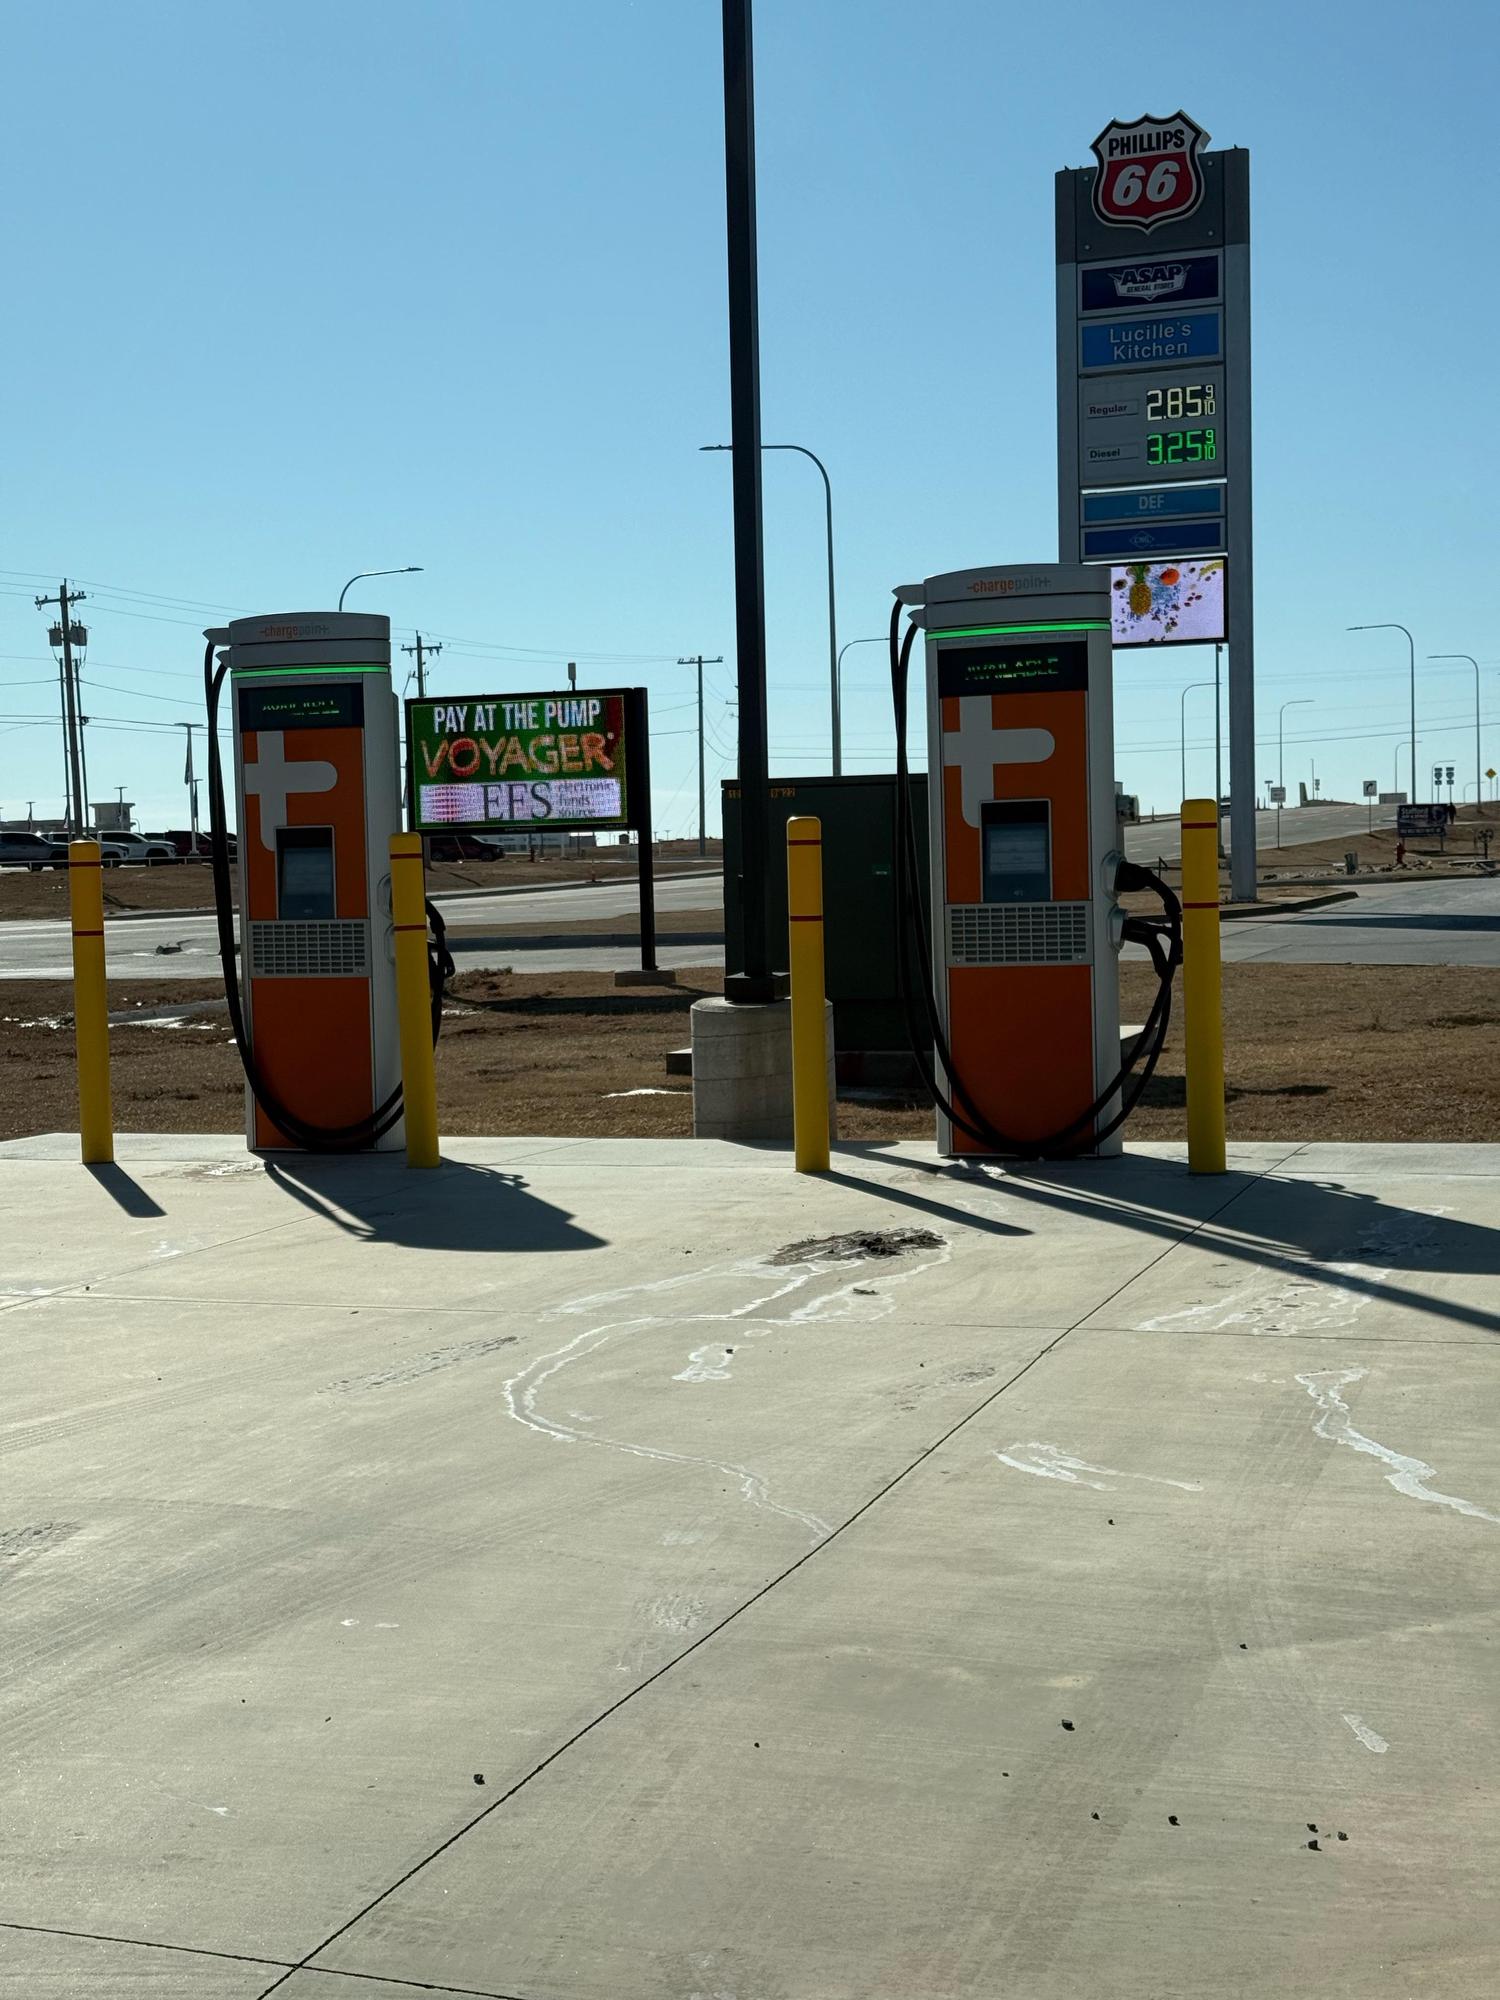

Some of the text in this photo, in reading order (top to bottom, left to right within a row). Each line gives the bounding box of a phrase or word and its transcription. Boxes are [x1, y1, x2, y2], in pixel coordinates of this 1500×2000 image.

[1109, 129, 1185, 156] PHILLIPS
[1113, 161, 1180, 206] 66
[1121, 265, 1183, 285] ASAP
[1126, 284, 1152, 293] GENERAL
[1110, 323, 1192, 343] Lucille's
[1114, 342, 1188, 360] Kitchen
[1089, 405, 1127, 415] Regular
[1147, 386, 1202, 421] 2.85
[1090, 449, 1120, 458] Diesel
[1147, 431, 1202, 465] 3.25
[1139, 495, 1164, 509] DEF
[434, 701, 600, 733] PAY AT THE PUMP
[421, 732, 614, 778] VOYAGER
[481, 783, 551, 820] EFS
